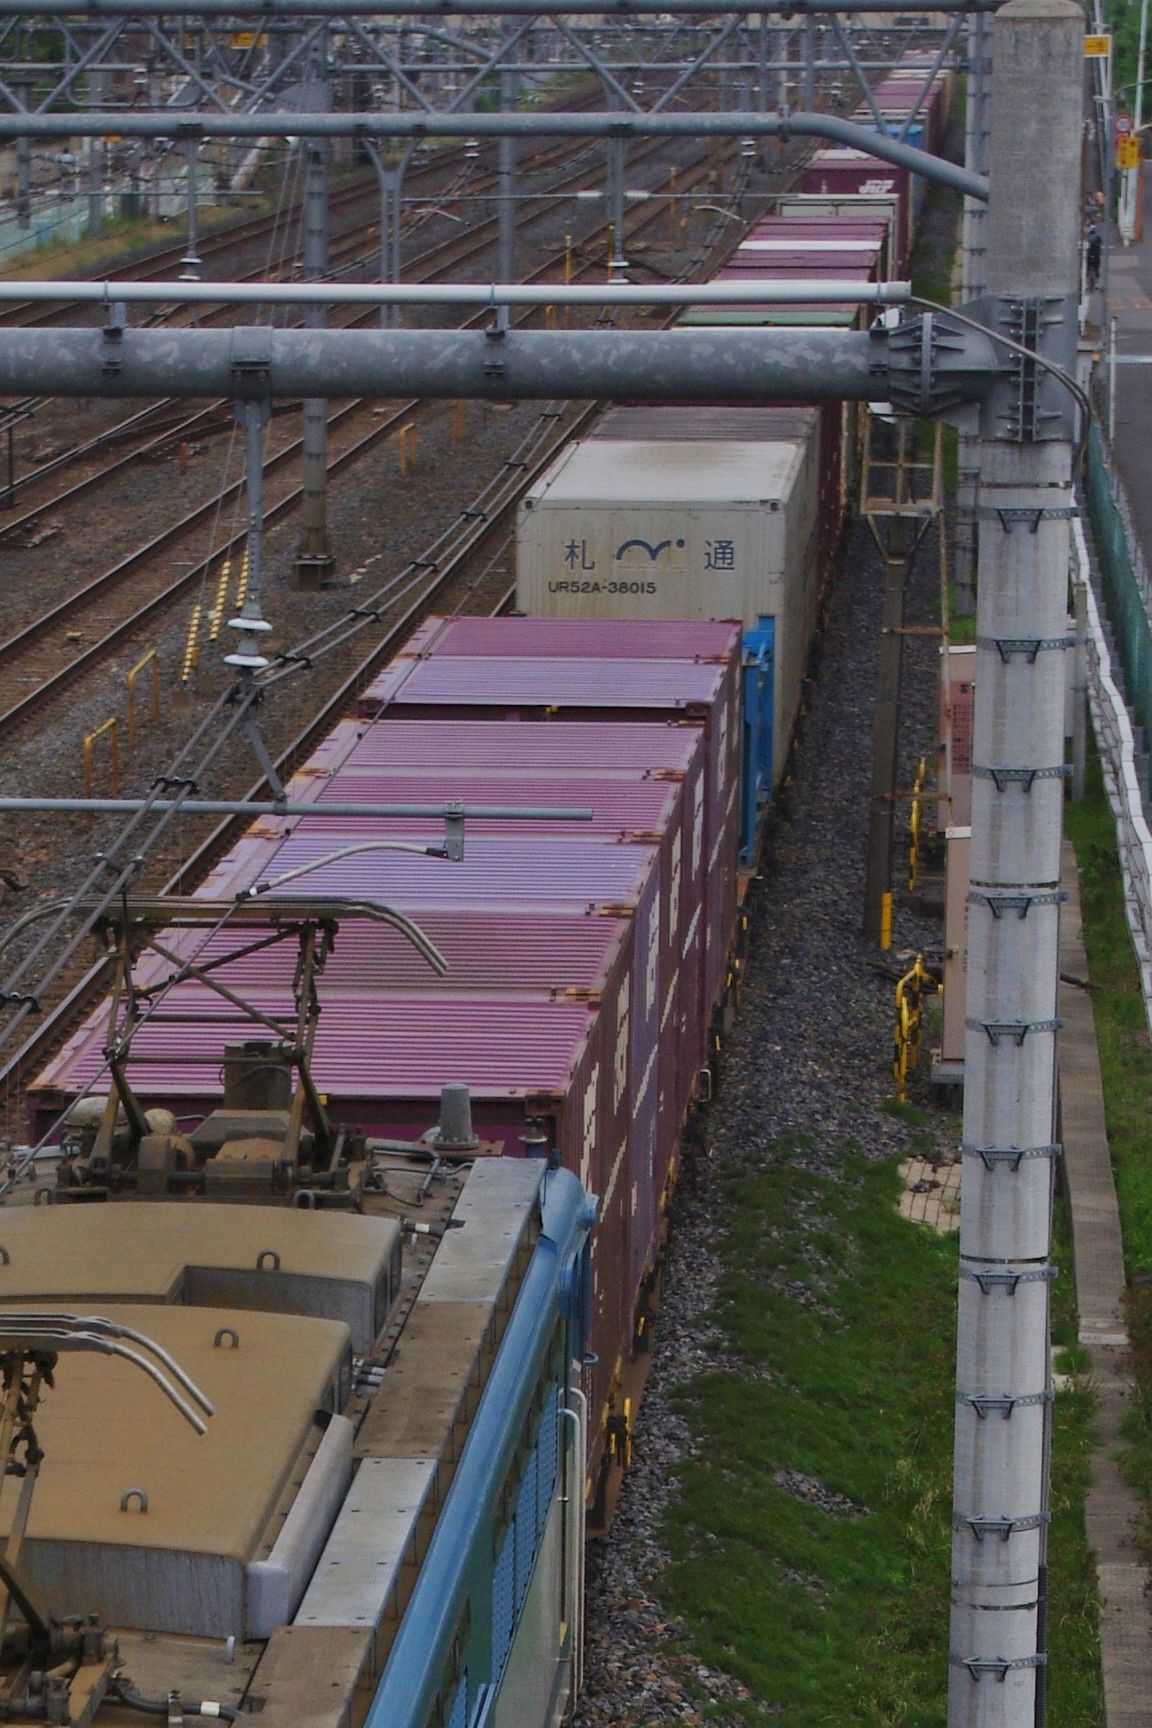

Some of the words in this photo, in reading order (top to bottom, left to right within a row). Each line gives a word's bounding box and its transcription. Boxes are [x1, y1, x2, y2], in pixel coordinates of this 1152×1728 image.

[565, 539, 596, 570] 札
[703, 540, 735, 570] 通
[548, 581, 657, 595] UR52A-38015
